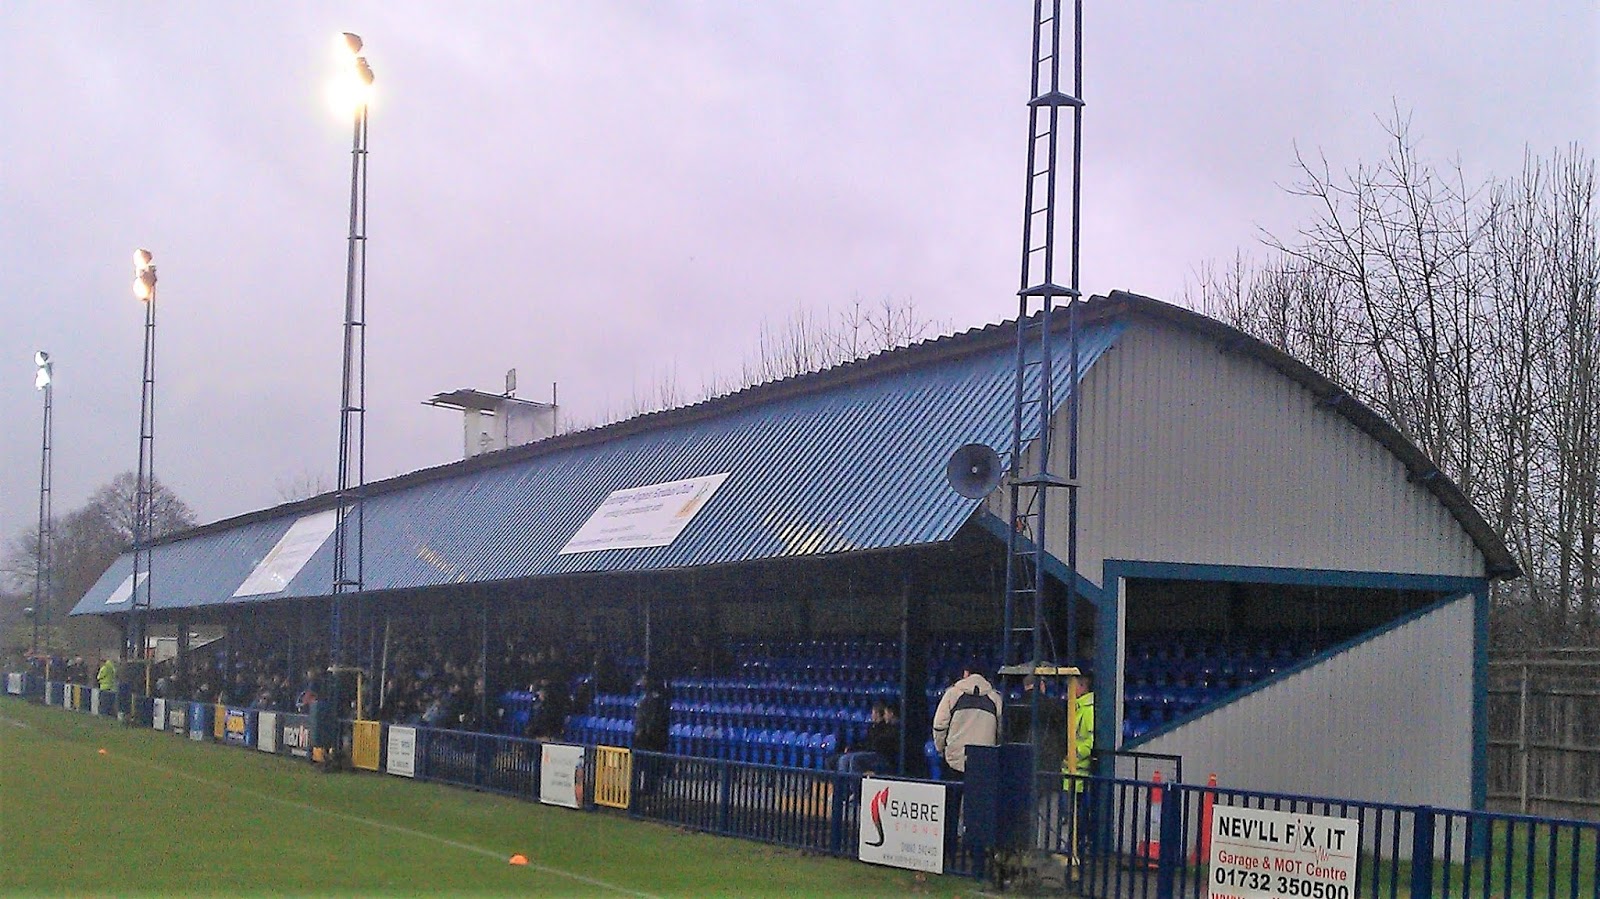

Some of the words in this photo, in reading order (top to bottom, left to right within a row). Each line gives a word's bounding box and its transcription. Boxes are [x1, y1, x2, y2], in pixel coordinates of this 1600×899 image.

[891, 800, 939, 822] SABRE
[1218, 816, 1279, 843] NEV'LL
[1327, 828, 1346, 850] IT
[1218, 850, 1259, 869] Garage
[1262, 856, 1271, 870] &
[1274, 859, 1303, 874] MOT
[1306, 863, 1347, 881] Centre
[1215, 867, 1271, 891] 01732
[1277, 876, 1349, 899] 350500
